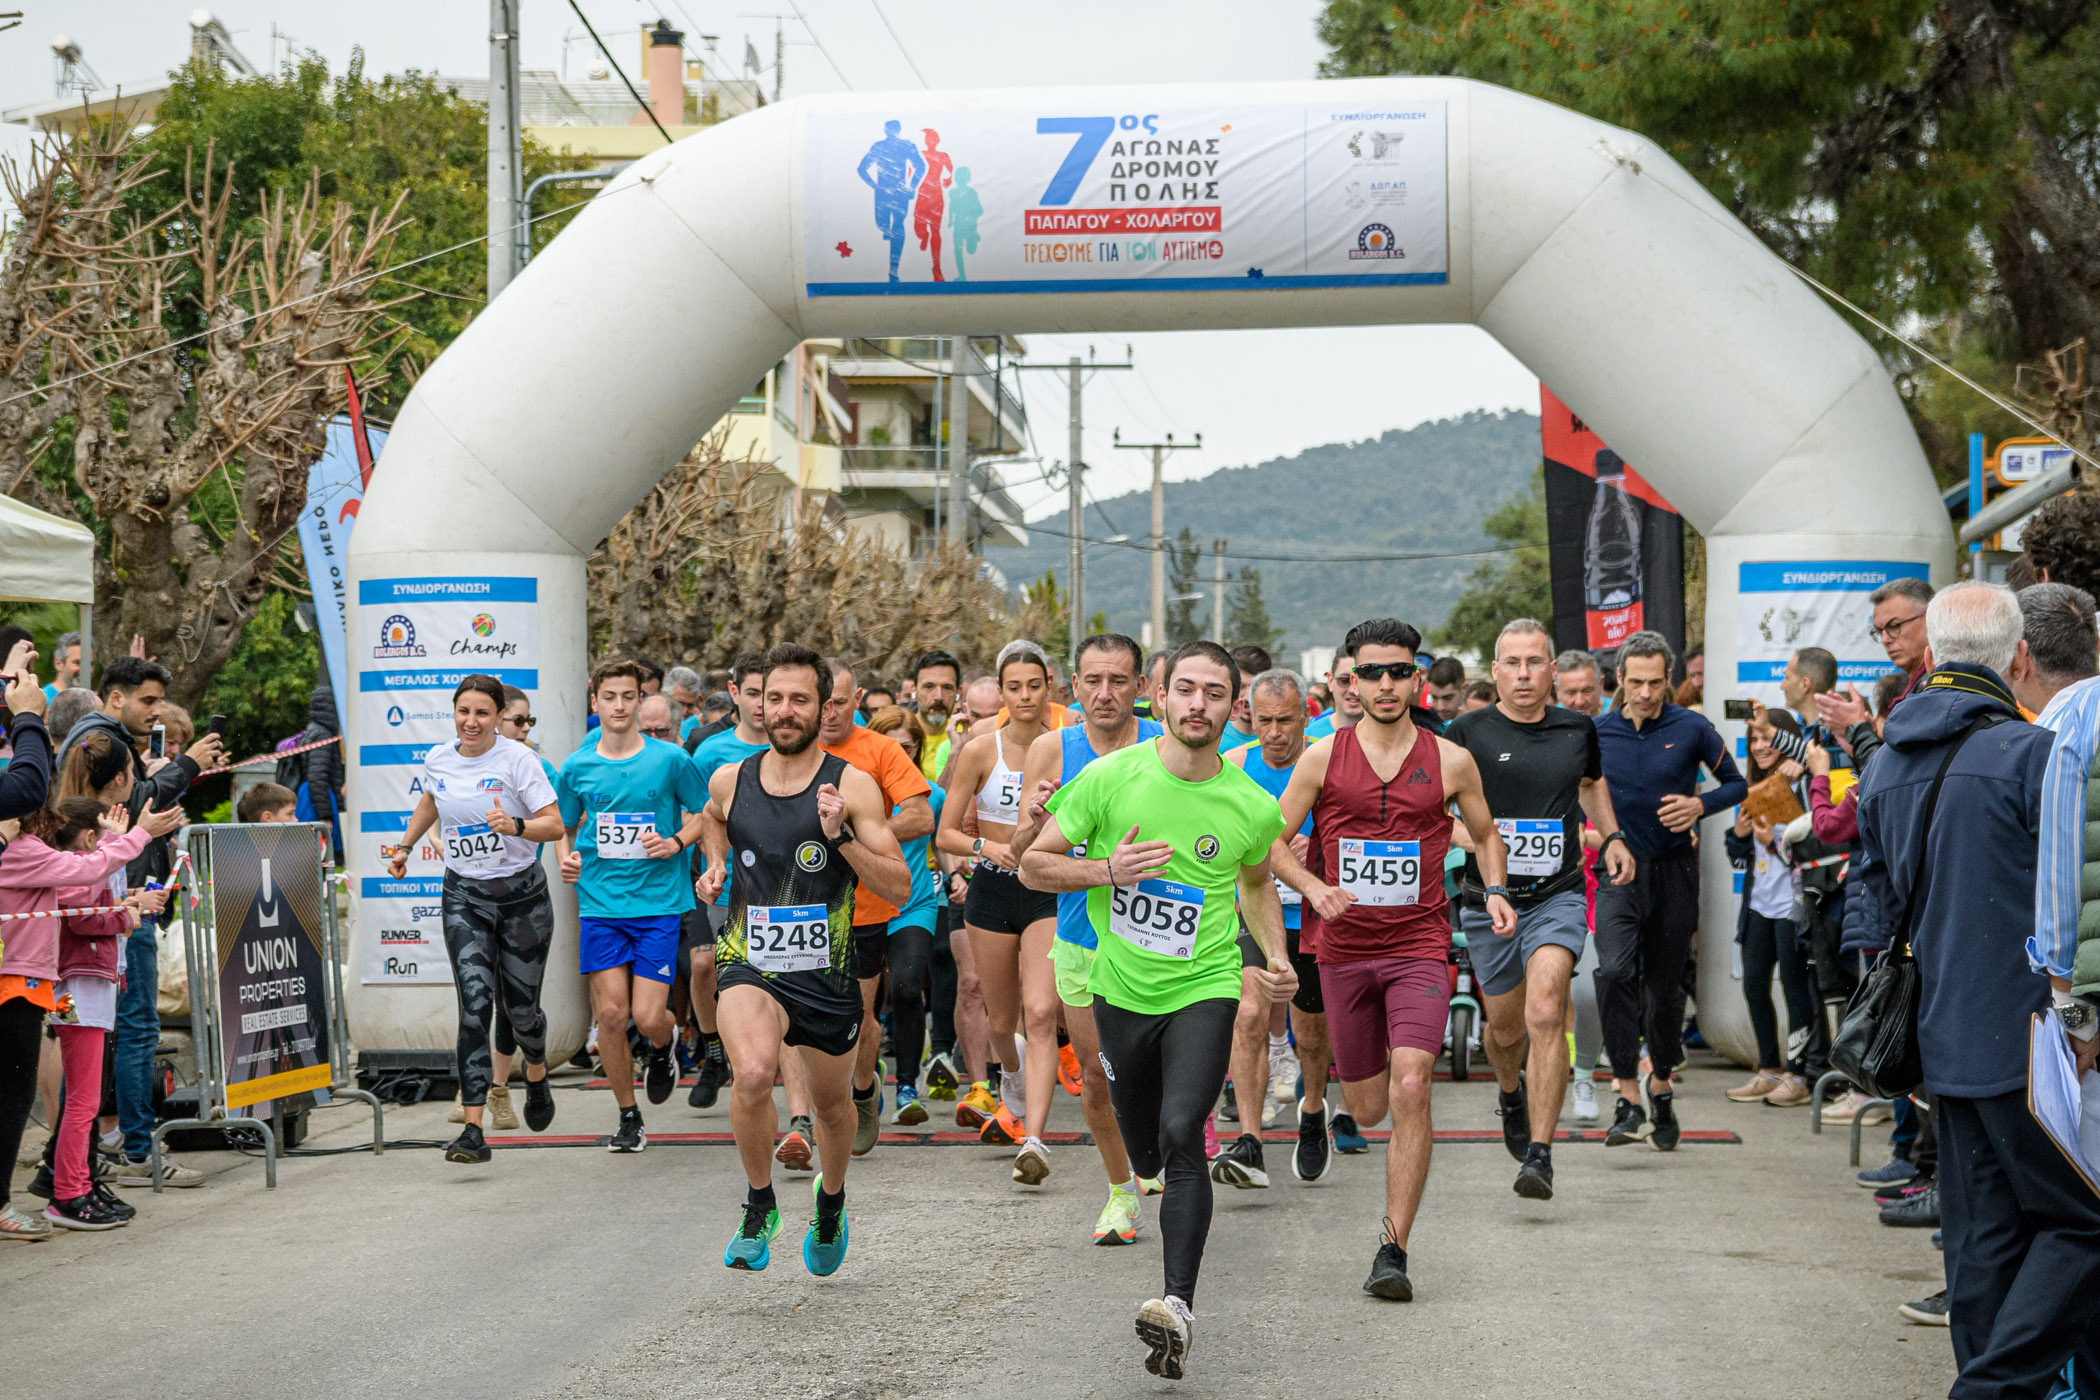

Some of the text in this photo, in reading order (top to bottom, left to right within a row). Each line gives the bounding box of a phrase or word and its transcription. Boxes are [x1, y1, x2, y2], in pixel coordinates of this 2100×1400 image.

[1330, 113, 1426, 121] ΣΥΝΔΙΟΡΓΑΝΩΣΗ
[1111, 139, 1220, 157] ΑΓΩΝΑΣ
[1110, 160, 1219, 179] ΔΡΟΜΟΥ
[1111, 181, 1219, 202] ΠΟΛΗΣ
[1029, 213, 1110, 230] ΠΑΠΑΓΟΥ
[1125, 212, 1216, 228] ΧΟΛΑΡΓΟΥ
[1024, 240, 1224, 263] ΤΡΕΧΟΥΜΕ ΓΙΑ ΤΟΝ ΑΥΤΙΣΜΟ
[1783, 572, 1887, 584] ΣΥΝΔΙΟΡΓΑΝΩΣΗ
[393, 583, 490, 595] ΣΥΝΔΙΟΡΓΑΝΩΣΗ
[450, 638, 517, 659] Champs
[385, 675, 439, 686] ΜΕΓΑΛΟΣ
[1931, 675, 1954, 684] Nikon
[448, 832, 503, 858] 5042
[1342, 857, 1418, 886] 5459
[380, 883, 420, 893] ΤΟΠΙΚΟΙ
[1165, 885, 1184, 896] 5km
[1112, 887, 1198, 937] 5058
[381, 930, 421, 940] RUNNER
[750, 923, 828, 952] 5248
[244, 937, 298, 975] UNION
[239, 976, 306, 1004] PROPERTIES
[244, 1007, 305, 1030] REAL ESTATE SERVICES
